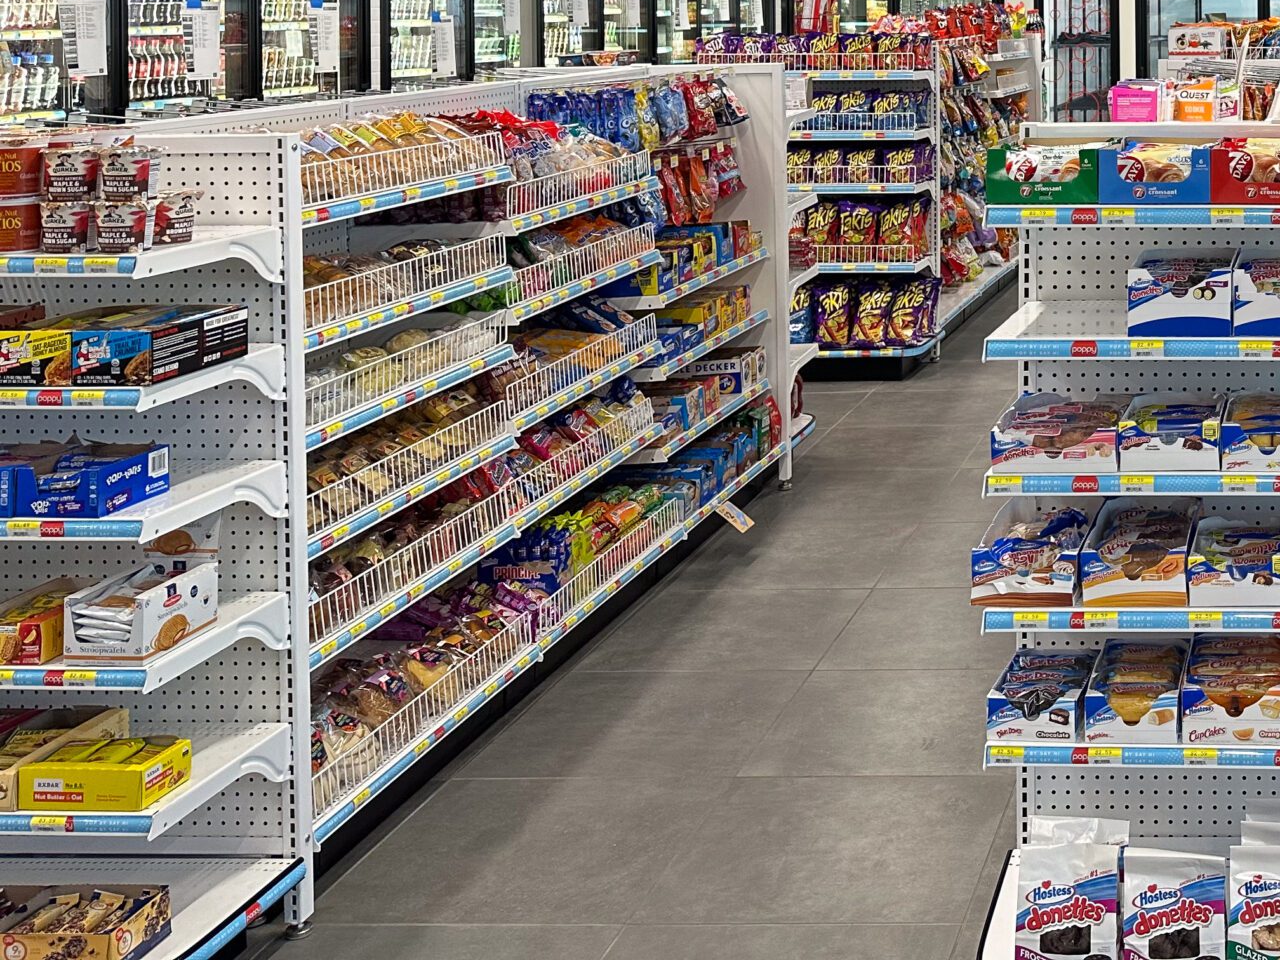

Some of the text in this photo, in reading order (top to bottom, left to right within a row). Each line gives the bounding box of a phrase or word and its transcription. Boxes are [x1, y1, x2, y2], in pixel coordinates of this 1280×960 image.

[810, 33, 838, 53] Takis
[1179, 89, 1210, 101] QUEST
[840, 210, 873, 232] Takis
[1072, 214, 1097, 222] poppy
[32, 338, 67, 351] OAT-RAGEOUS
[695, 361, 737, 372] DECKER
[38, 395, 61, 403] poppy
[1072, 480, 1098, 490] poppy
[80, 646, 126, 655] Stroopwafels
[1036, 731, 1070, 739] Chocolate
[1033, 886, 1072, 902] Hostess
[1139, 891, 1178, 906] Hostess
[1026, 898, 1104, 930] donettes
[1134, 901, 1212, 935] donettes
